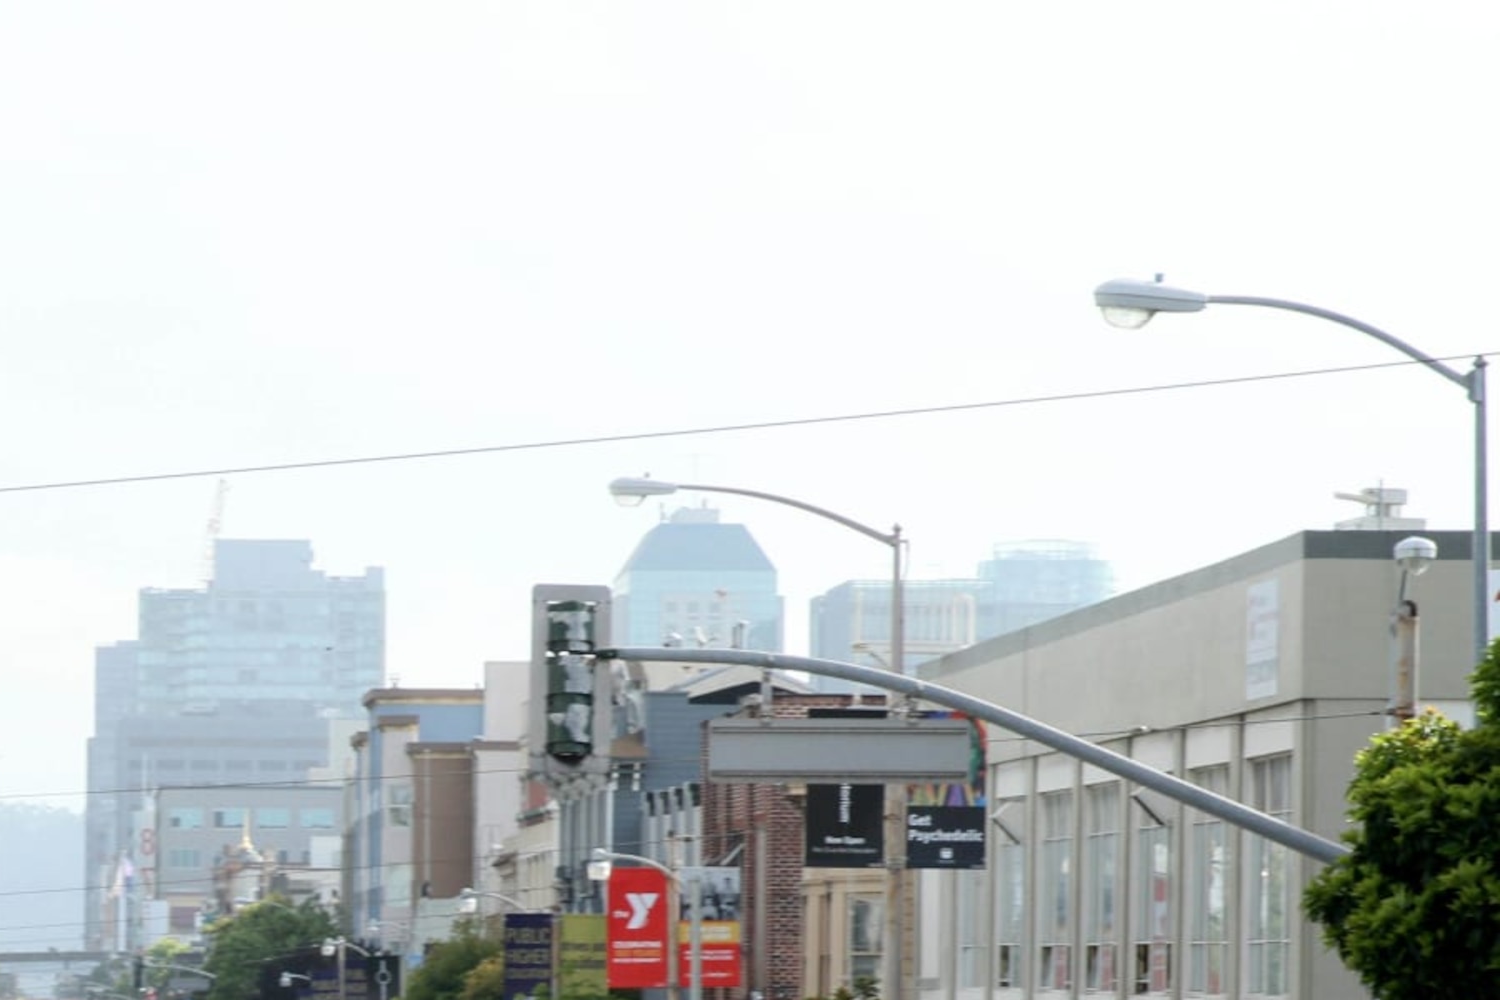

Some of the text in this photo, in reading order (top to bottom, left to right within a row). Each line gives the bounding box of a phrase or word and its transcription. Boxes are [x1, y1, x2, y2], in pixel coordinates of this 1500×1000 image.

[908, 813, 932, 827] Get
[908, 829, 984, 845] Psychedelic
[506, 928, 551, 945] PUBLIC
